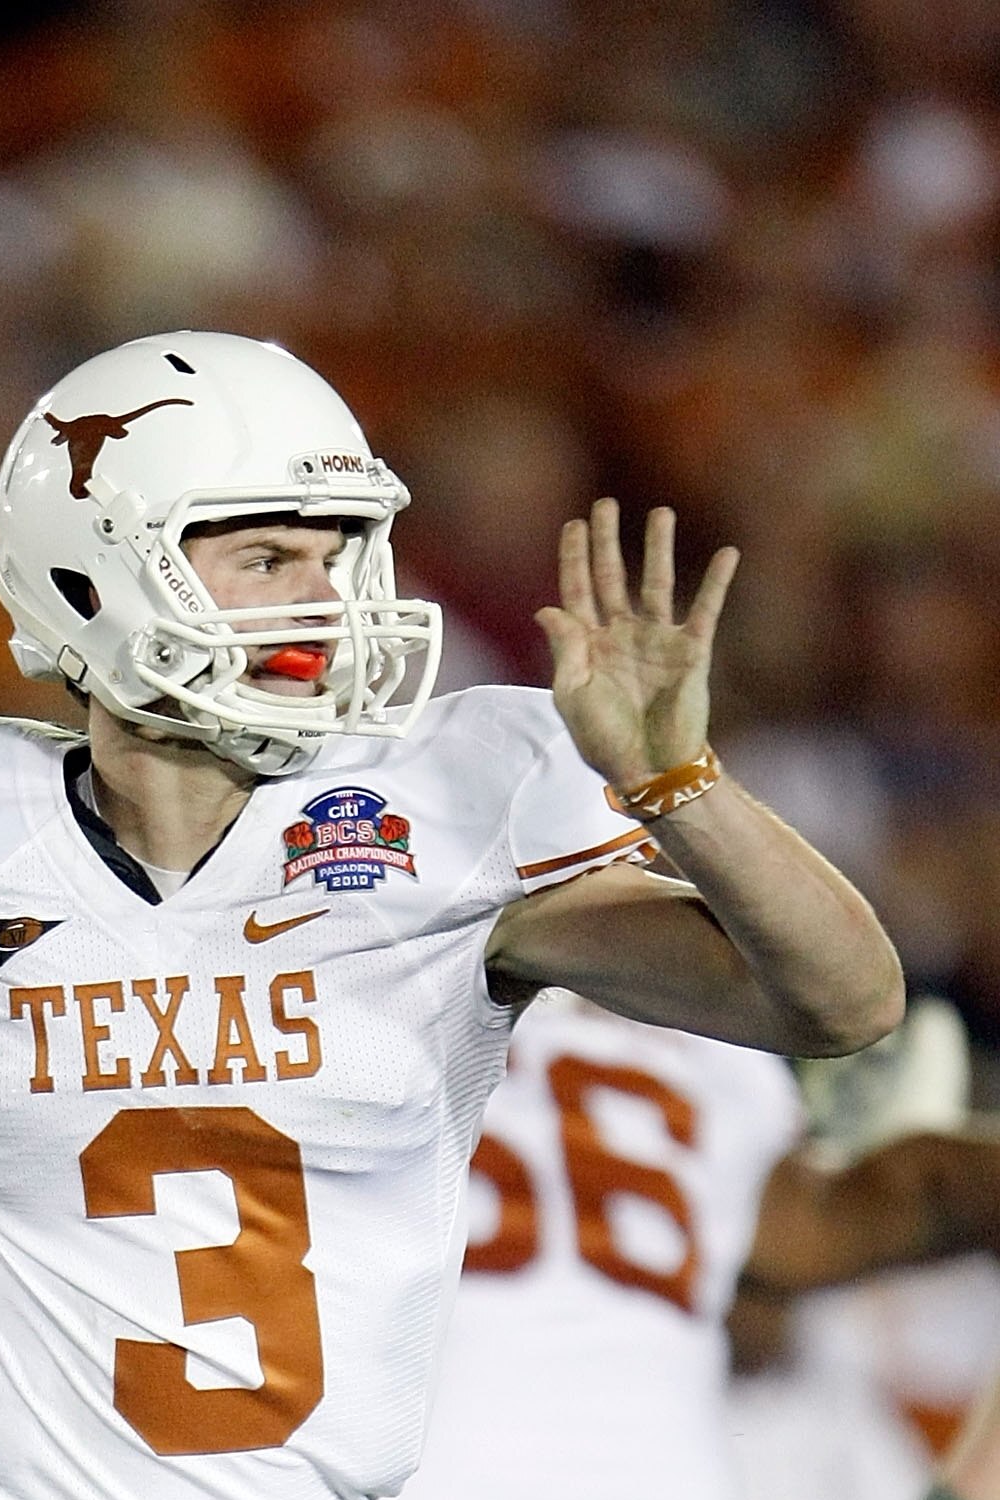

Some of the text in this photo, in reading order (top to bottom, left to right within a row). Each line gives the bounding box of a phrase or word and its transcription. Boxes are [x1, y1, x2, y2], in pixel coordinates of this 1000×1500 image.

[320, 454, 365, 474] HORNS
[673, 778, 716, 808] ALL
[328, 802, 359, 818] citi
[317, 820, 375, 847] BCS
[288, 847, 409, 876] NATIONAL CHAMPIONSHIP
[320, 864, 380, 877] PASADENA
[332, 875, 368, 887] 2010
[9, 970, 323, 1093] TEXAS
[79, 1106, 325, 1457] 3
